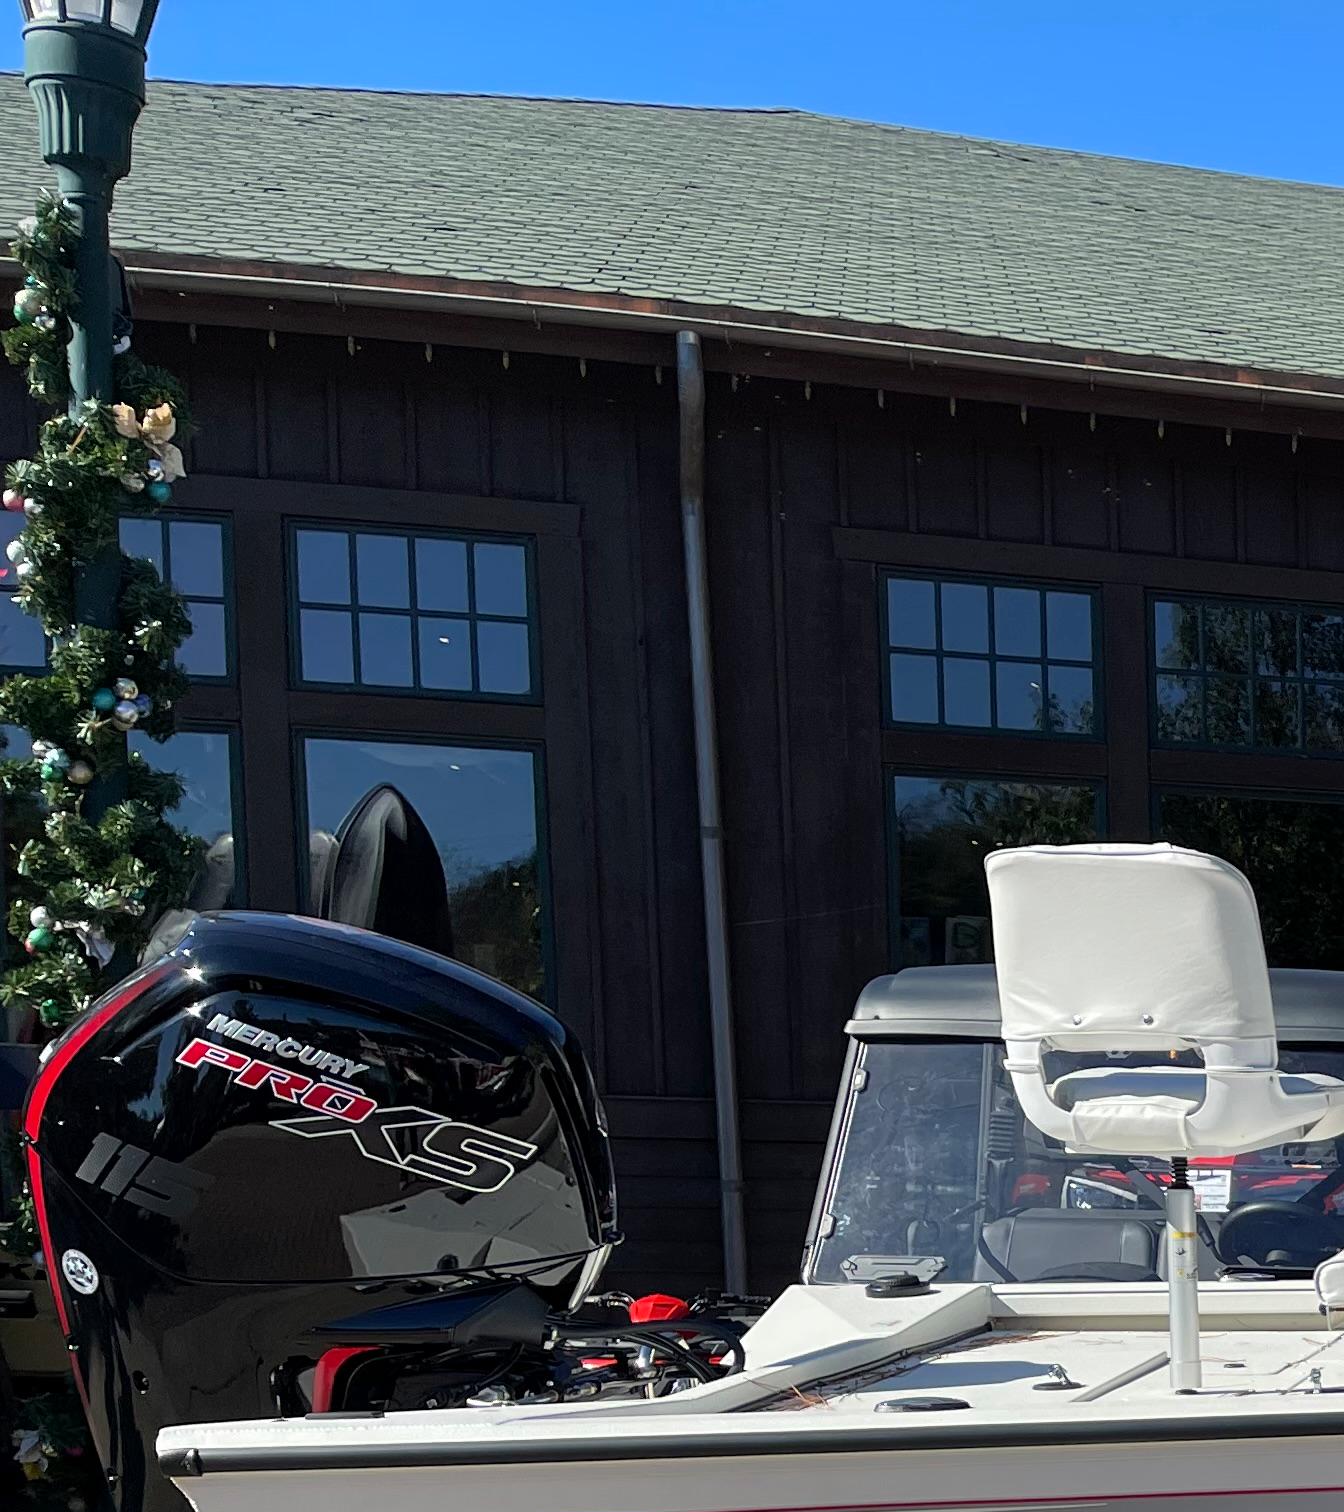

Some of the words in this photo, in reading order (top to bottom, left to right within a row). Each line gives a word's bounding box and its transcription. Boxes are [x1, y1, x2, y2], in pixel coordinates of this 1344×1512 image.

[175, 1037, 378, 1124] PRO
[206, 1013, 370, 1079] MERCURY
[75, 1131, 217, 1218] 115
[268, 1105, 538, 1193] XS
